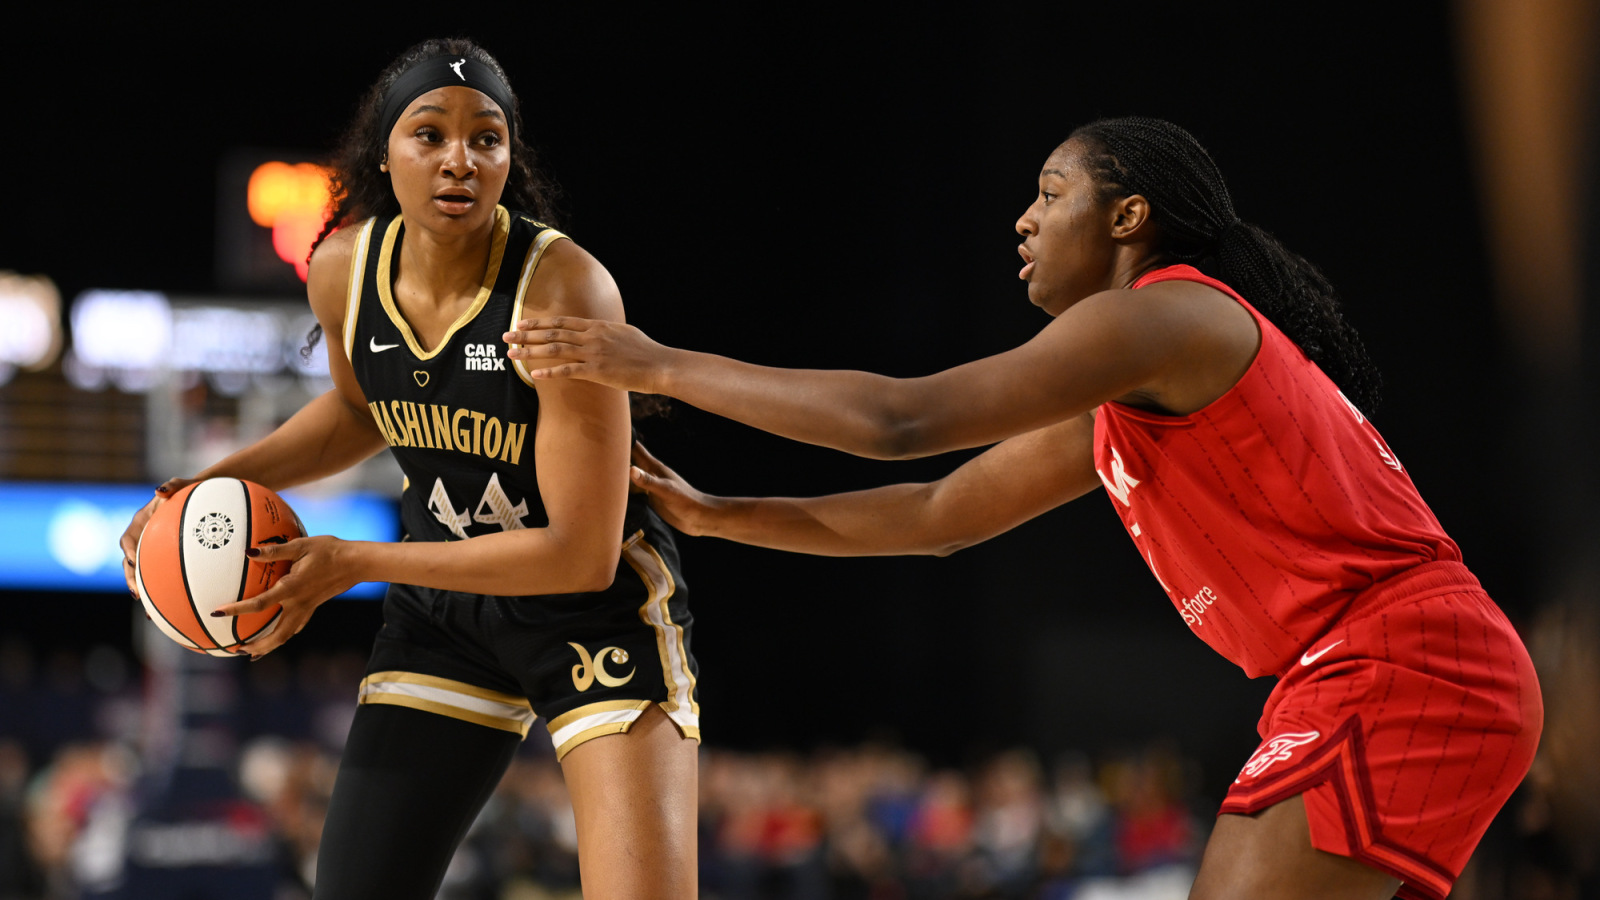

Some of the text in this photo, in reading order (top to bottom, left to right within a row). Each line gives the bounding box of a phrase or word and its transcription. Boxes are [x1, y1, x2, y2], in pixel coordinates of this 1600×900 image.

[464, 343, 497, 358] CAR
[465, 357, 506, 371] max
[368, 400, 528, 465] WASHINGTON
[428, 472, 529, 540] 44
[1180, 586, 1217, 627] sforce
